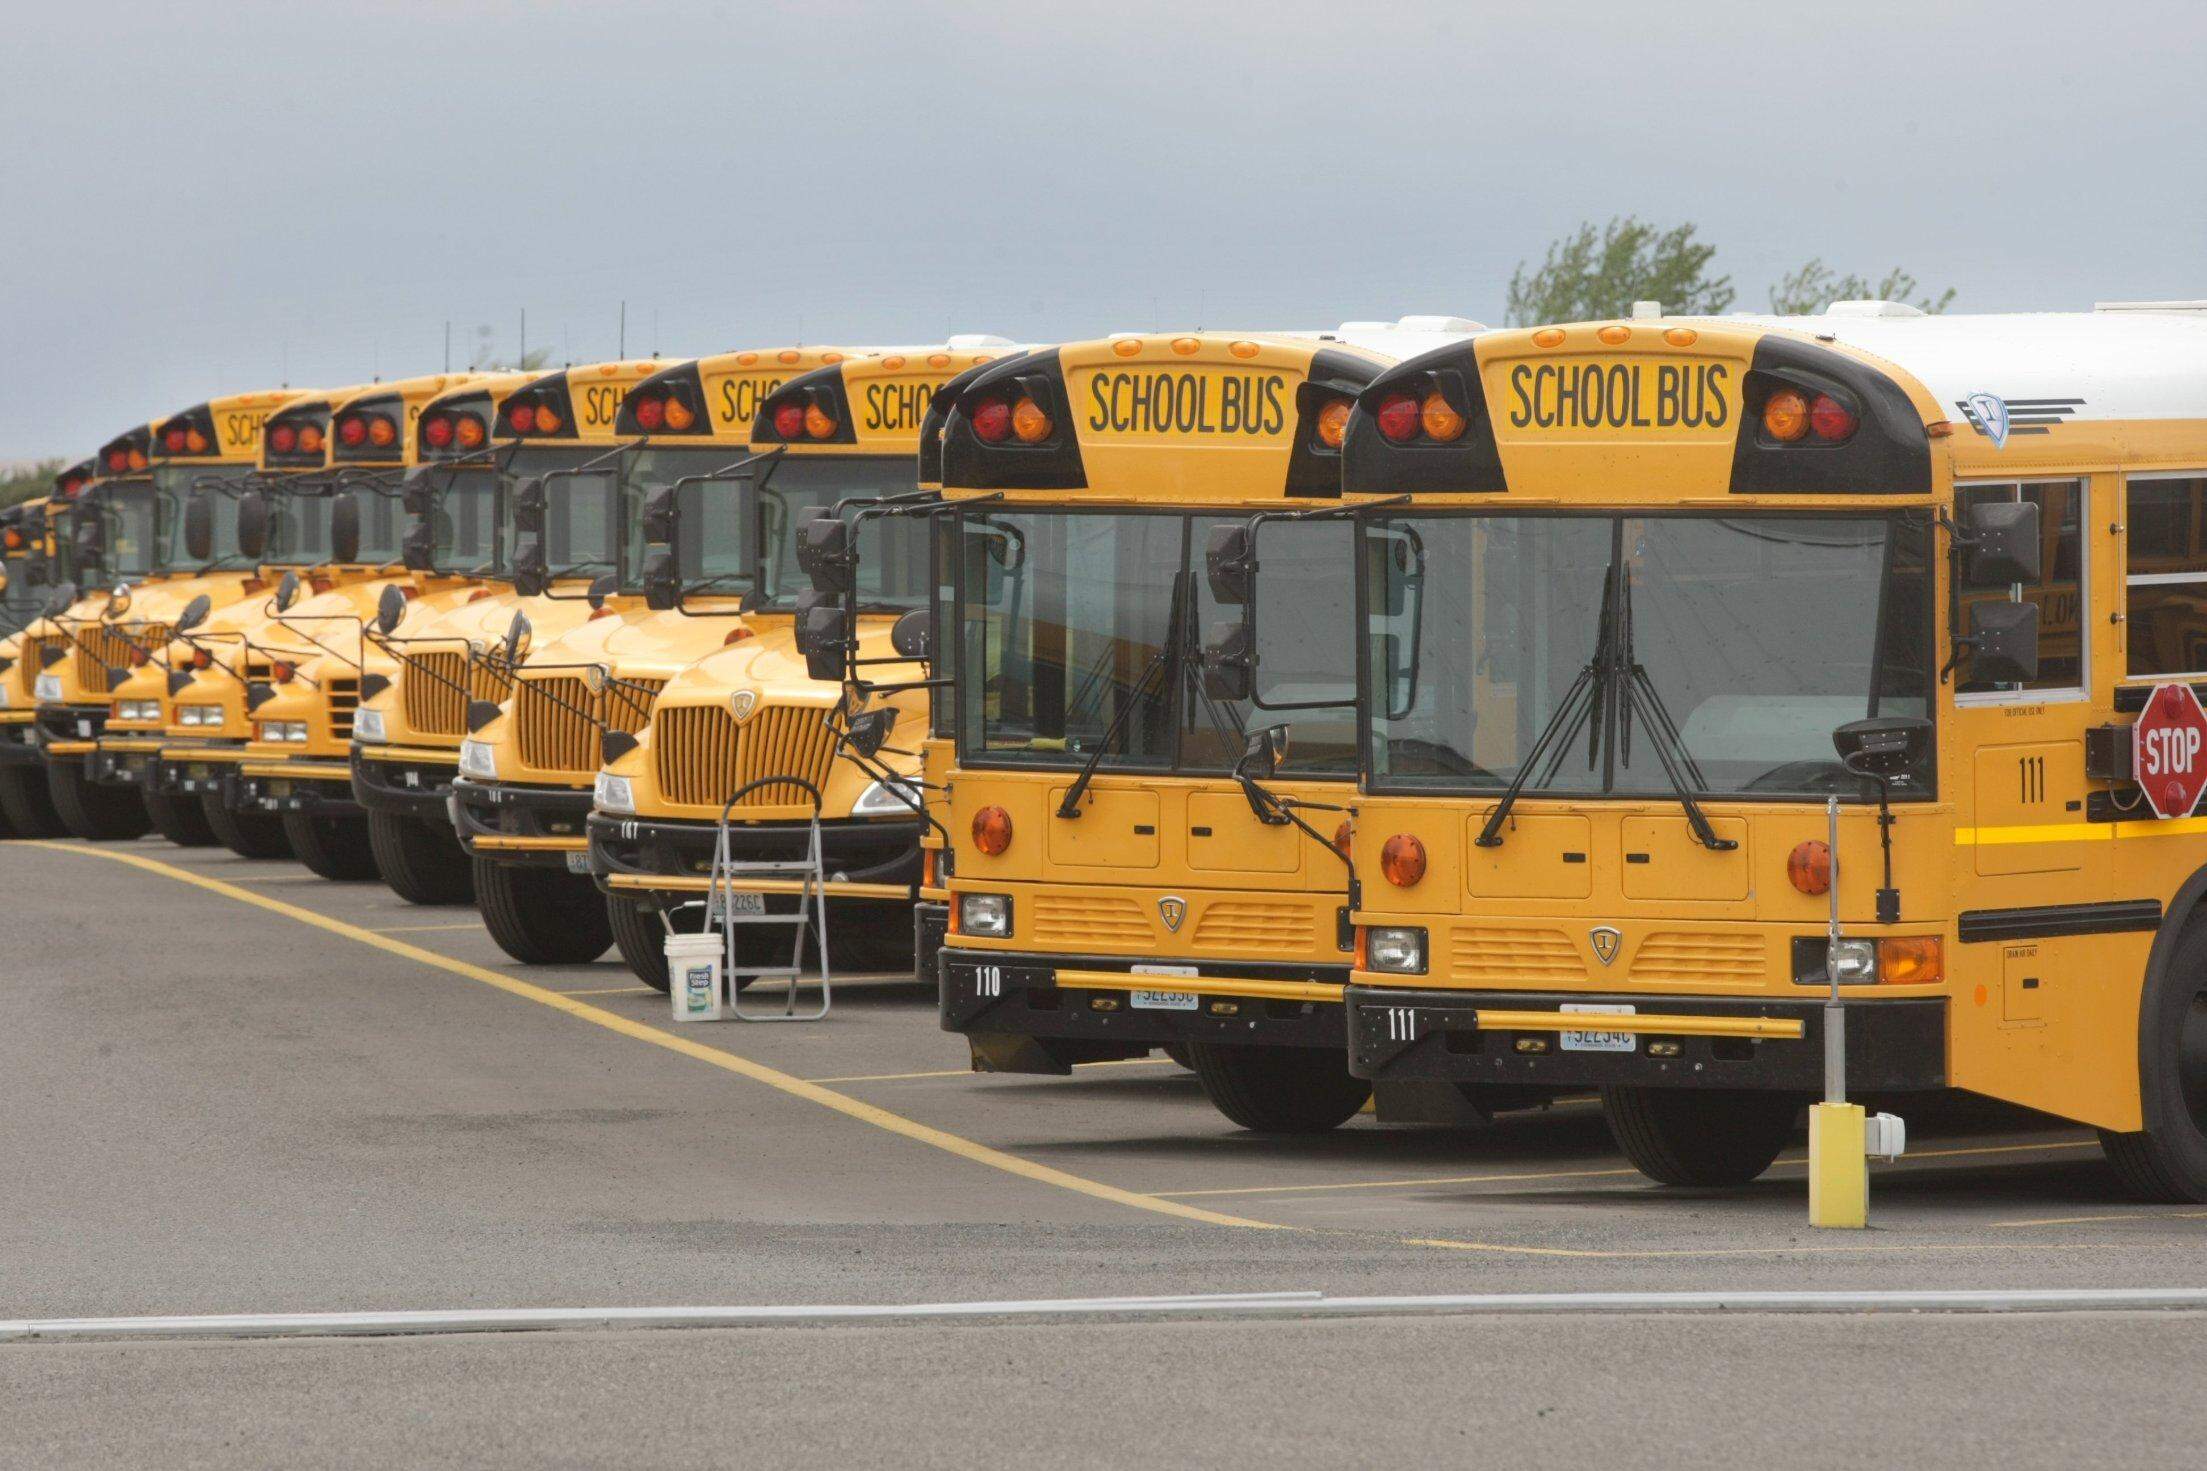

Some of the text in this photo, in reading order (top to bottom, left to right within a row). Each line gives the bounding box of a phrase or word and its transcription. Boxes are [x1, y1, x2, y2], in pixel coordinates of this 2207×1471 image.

[586, 386, 635, 425] SCH
[1089, 373, 1285, 435] SCHOOL BUS
[1510, 363, 1728, 428] SCHOOL BUS
[228, 414, 269, 446] SCH
[2146, 727, 2201, 775] STOP
[2019, 756, 2044, 803] 111
[975, 966, 1000, 996] 110
[1389, 1008, 1414, 1040] 111
